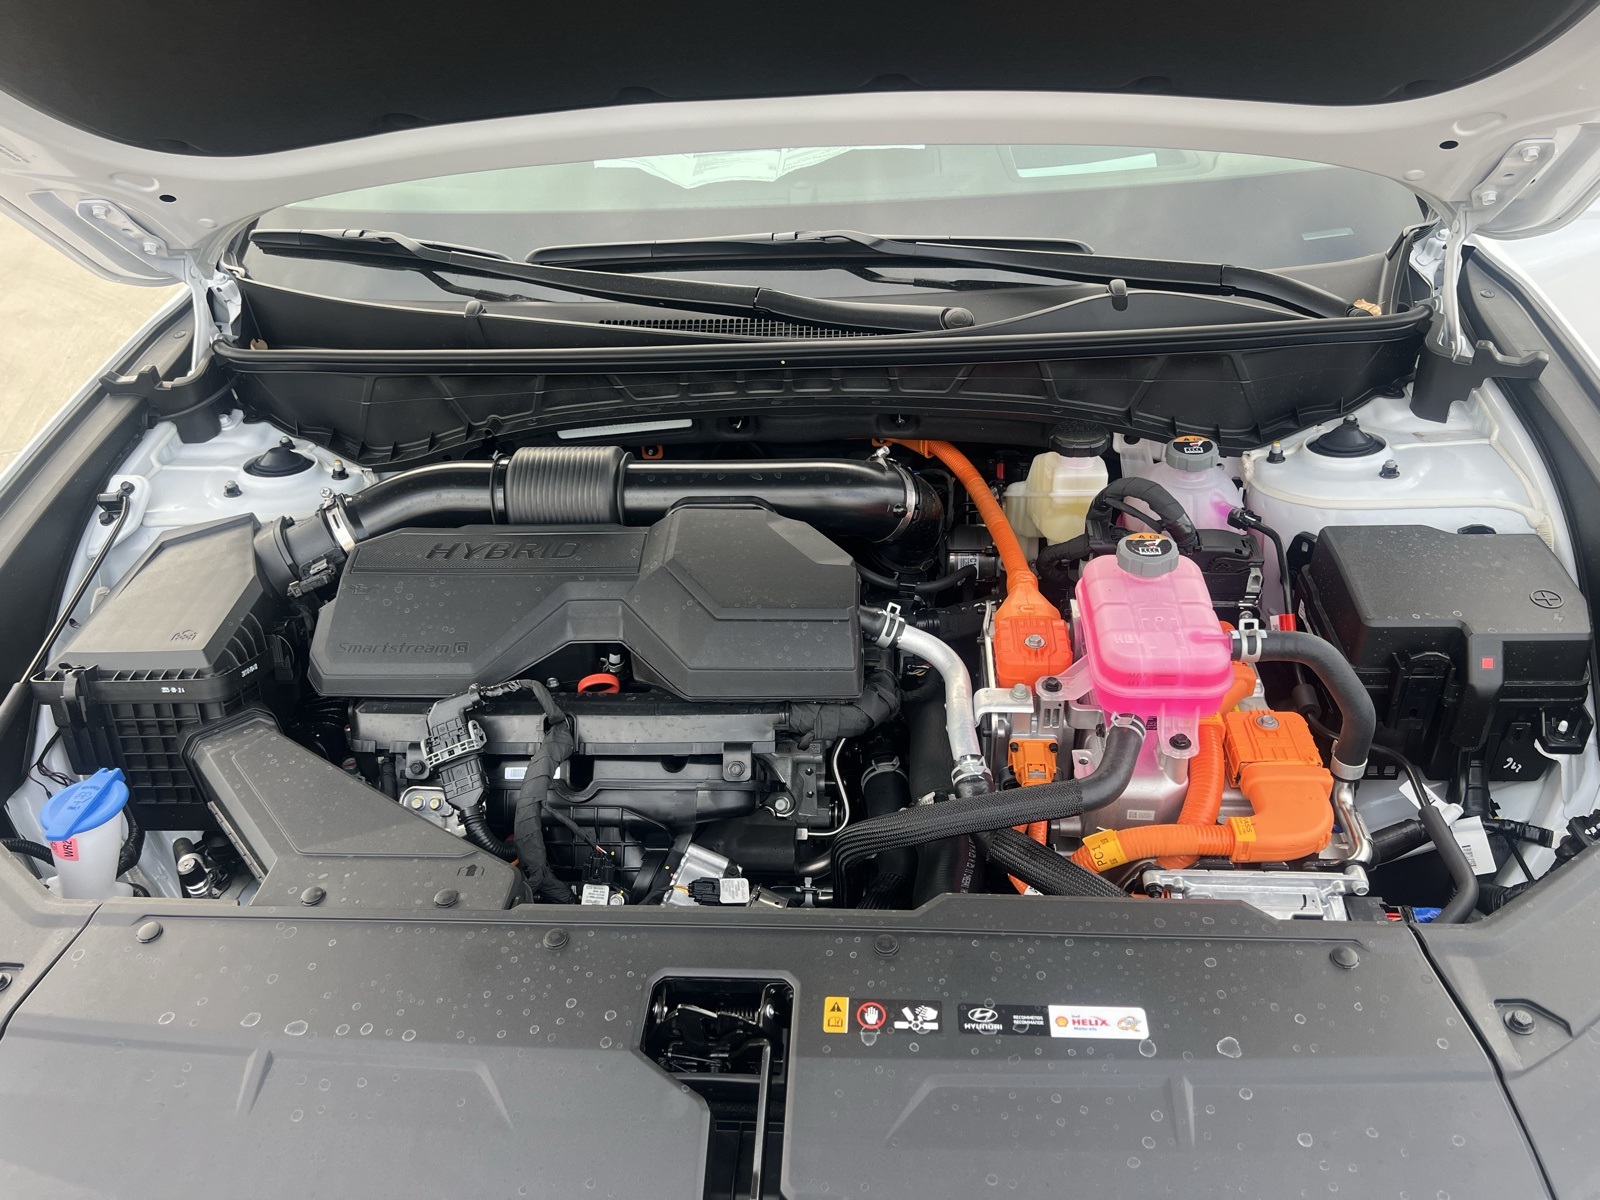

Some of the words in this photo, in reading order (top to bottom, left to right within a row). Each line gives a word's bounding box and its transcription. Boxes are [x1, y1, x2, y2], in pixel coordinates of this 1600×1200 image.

[425, 541, 582, 561] HYBRID
[338, 641, 451, 654] Smartstream
[1091, 844, 1108, 867] PC1
[963, 1023, 1003, 1031] HYUNDAI
[1071, 1018, 1109, 1027] HELIX
